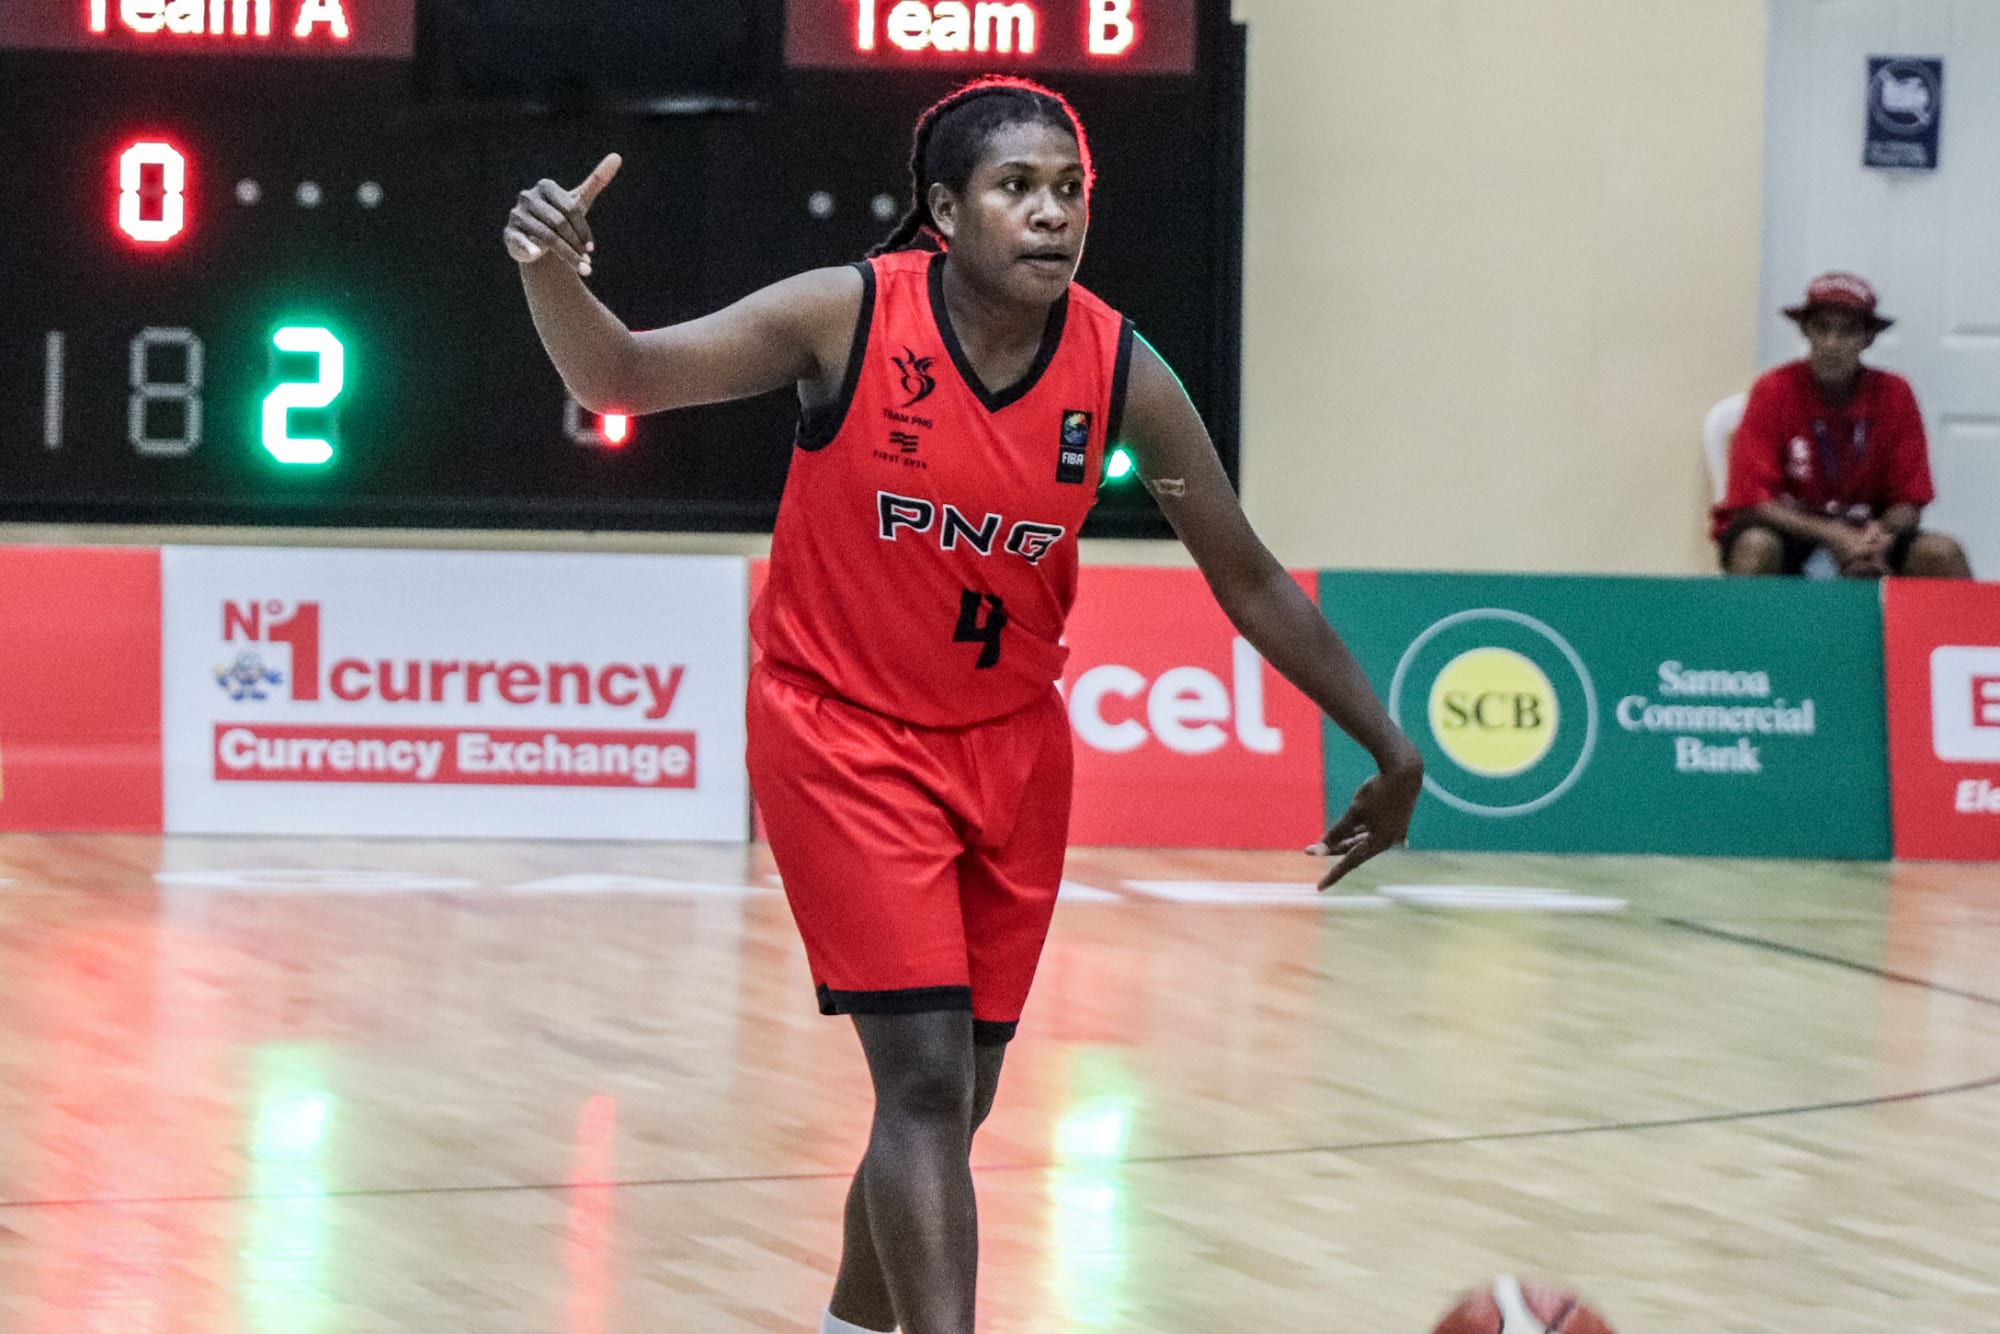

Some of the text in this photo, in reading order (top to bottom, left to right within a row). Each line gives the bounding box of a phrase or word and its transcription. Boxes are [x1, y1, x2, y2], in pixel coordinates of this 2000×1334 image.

[294, 0, 349, 38] A
[858, 0, 1134, 54] Team B
[119, 143, 185, 241] 0
[883, 408, 909, 422] TEAM
[1062, 452, 1084, 465] FIBA
[877, 490, 1065, 565] PNG
[953, 588, 1007, 669] 4
[329, 656, 686, 720] currency
[1658, 660, 1769, 697] Samoa
[1442, 691, 1541, 731] SCB
[1616, 695, 1815, 734] Commercial
[219, 727, 690, 783] Currency Exchange
[1675, 737, 1762, 773] Bank
